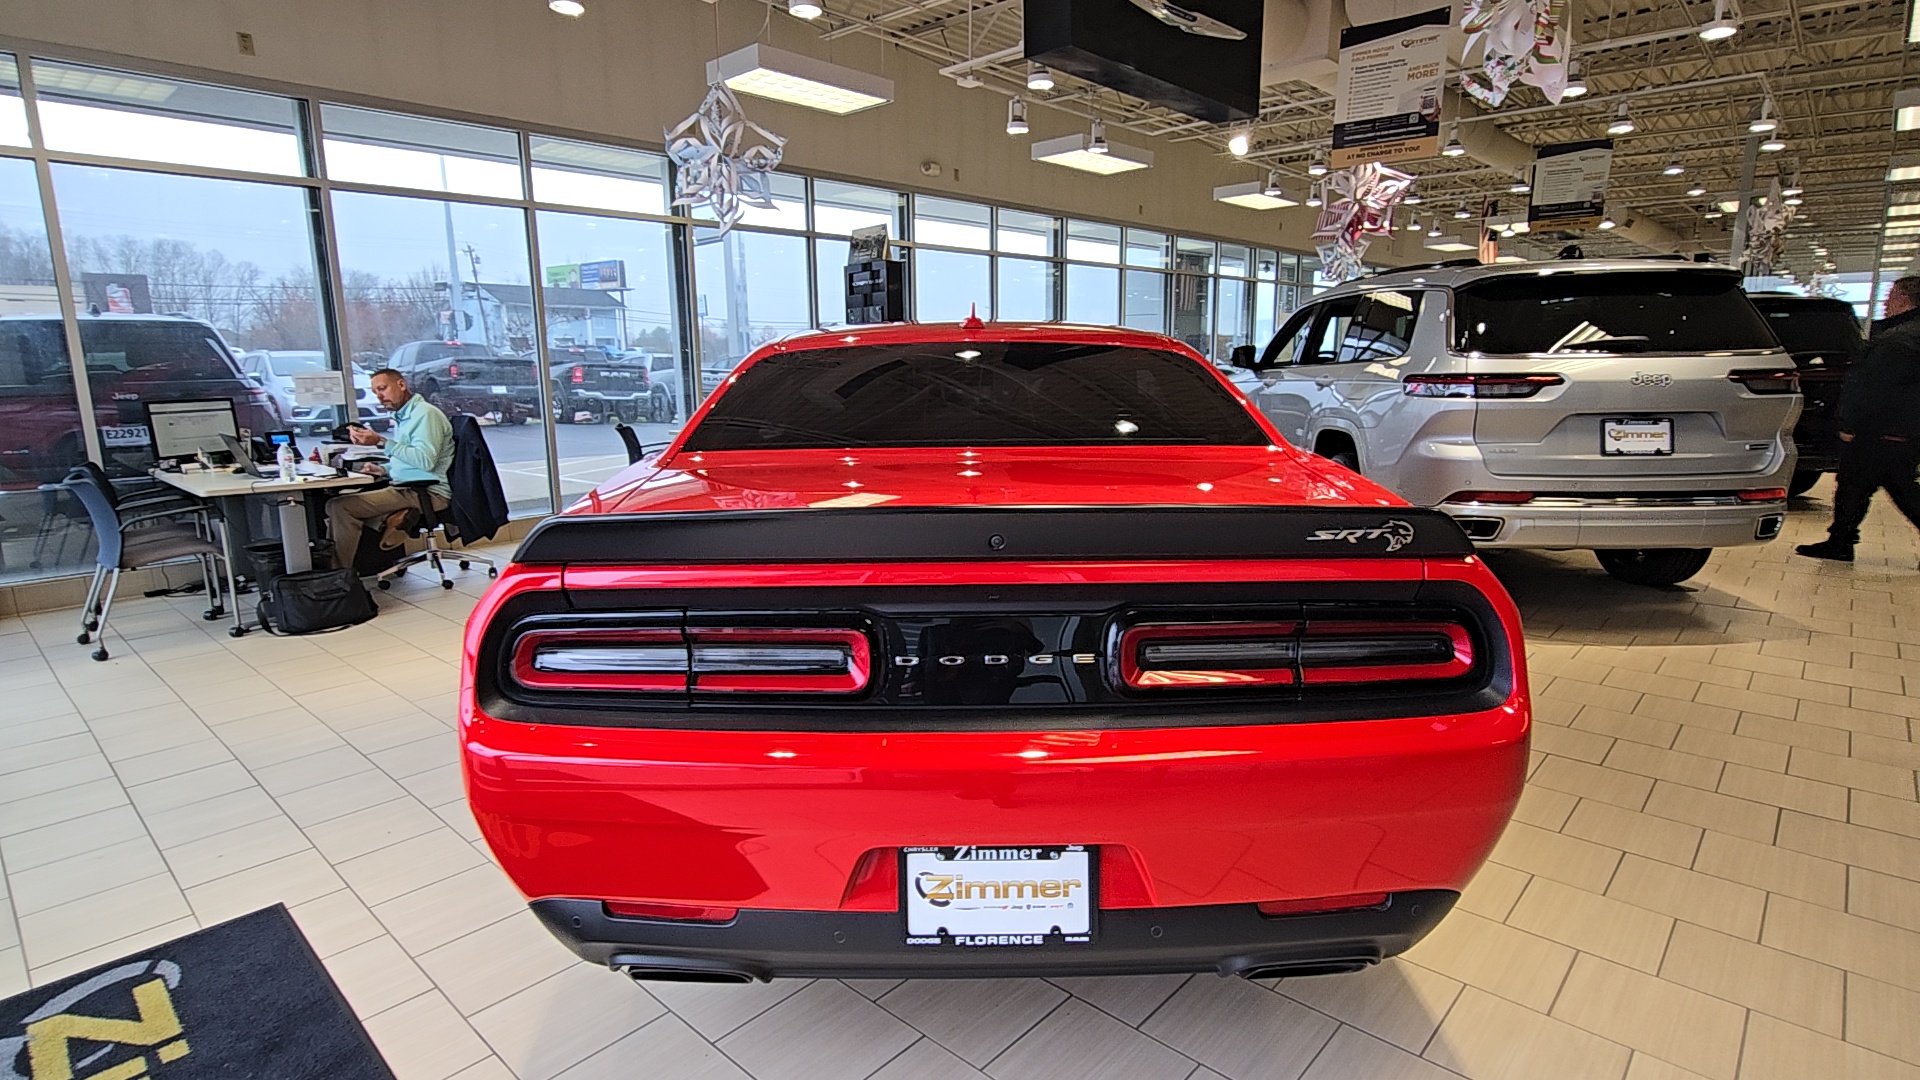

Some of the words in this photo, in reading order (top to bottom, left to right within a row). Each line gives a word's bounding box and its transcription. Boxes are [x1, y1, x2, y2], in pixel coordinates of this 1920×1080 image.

[1408, 64, 1422, 72] AND
[1422, 62, 1440, 70] MUCH
[1407, 68, 1439, 81] MORE!
[1366, 149, 1392, 158] CHARGE
[1404, 145, 1420, 153] YOU!
[1630, 370, 1673, 387] Jeep
[111, 392, 139, 400] Jeep
[104, 428, 149, 440] E22921
[1612, 429, 1668, 439] Zimmer
[1306, 529, 1393, 544] SRT
[894, 653, 1097, 666] DODGE
[953, 845, 1043, 861] Zimmer
[925, 874, 1082, 900] Zimmer
[906, 937, 942, 945] DODGE
[954, 935, 1044, 946] FLORENCE
[26, 978, 192, 1080] Zi
